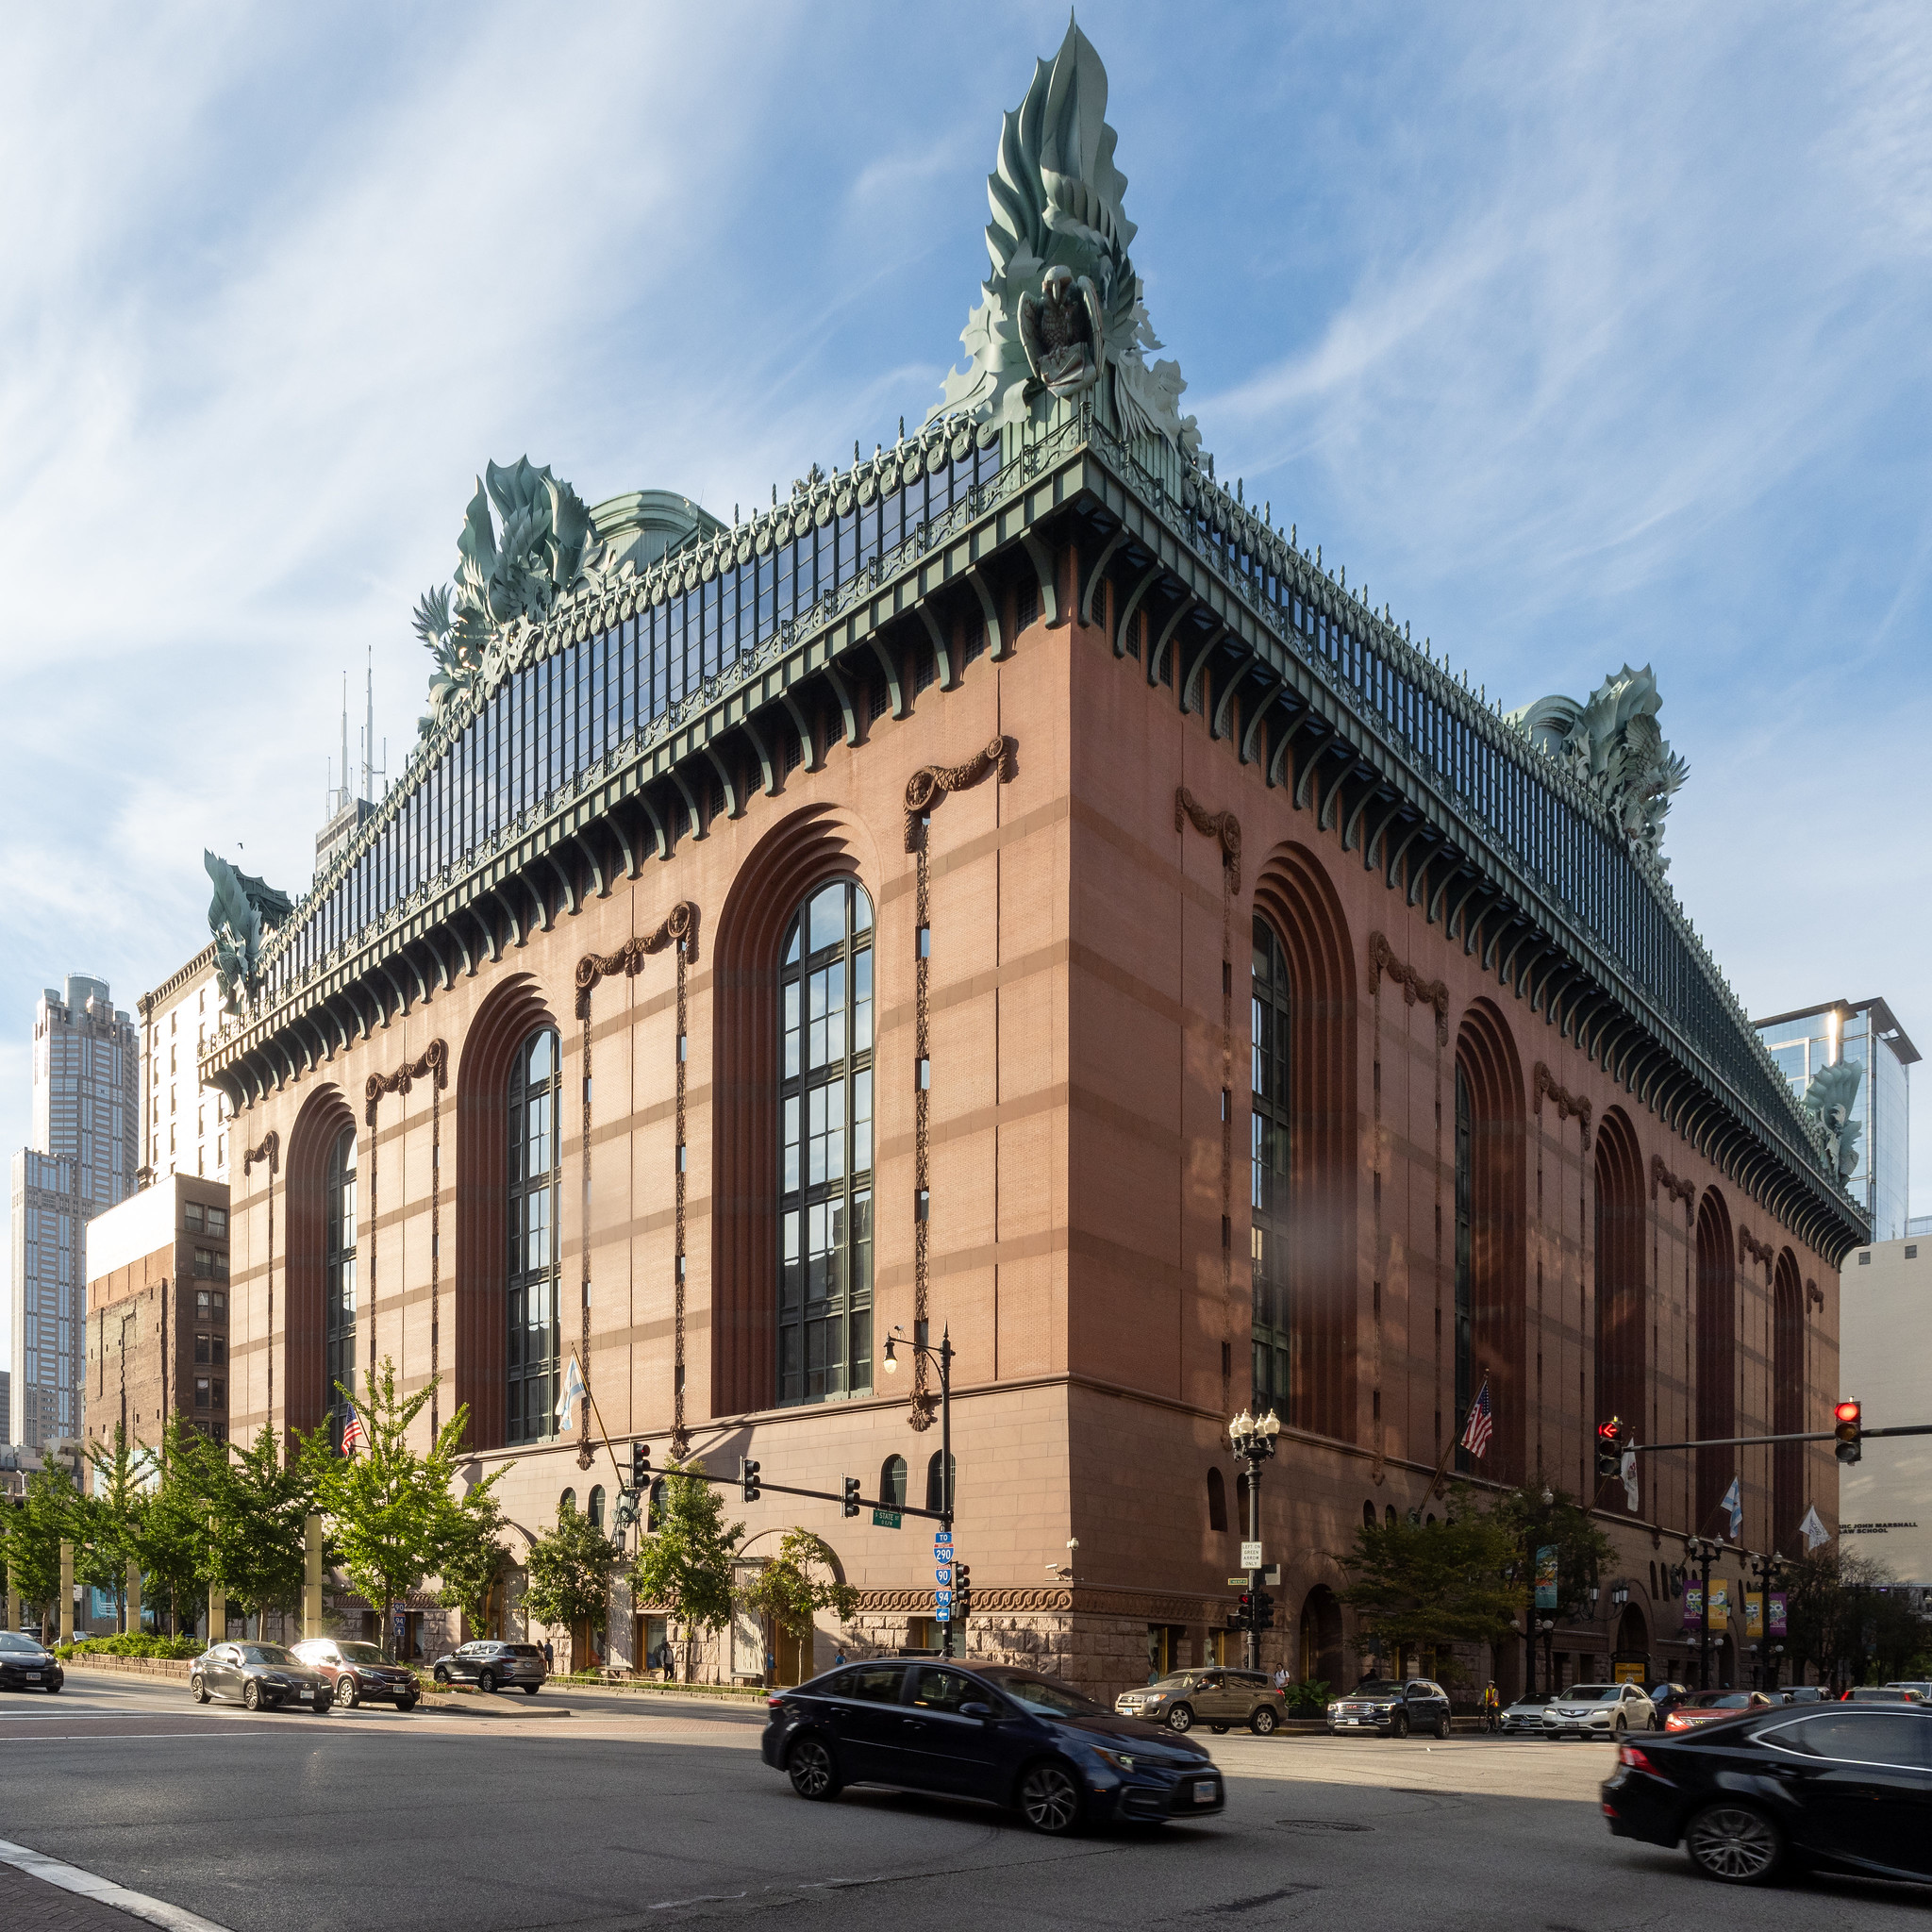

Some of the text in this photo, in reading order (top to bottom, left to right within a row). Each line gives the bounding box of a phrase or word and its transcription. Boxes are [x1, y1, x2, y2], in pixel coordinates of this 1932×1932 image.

[879, 1512, 894, 1521] STATE
[936, 1549, 951, 1560] 290
[938, 1570, 948, 1581] 90
[939, 1591, 949, 1603] 94
